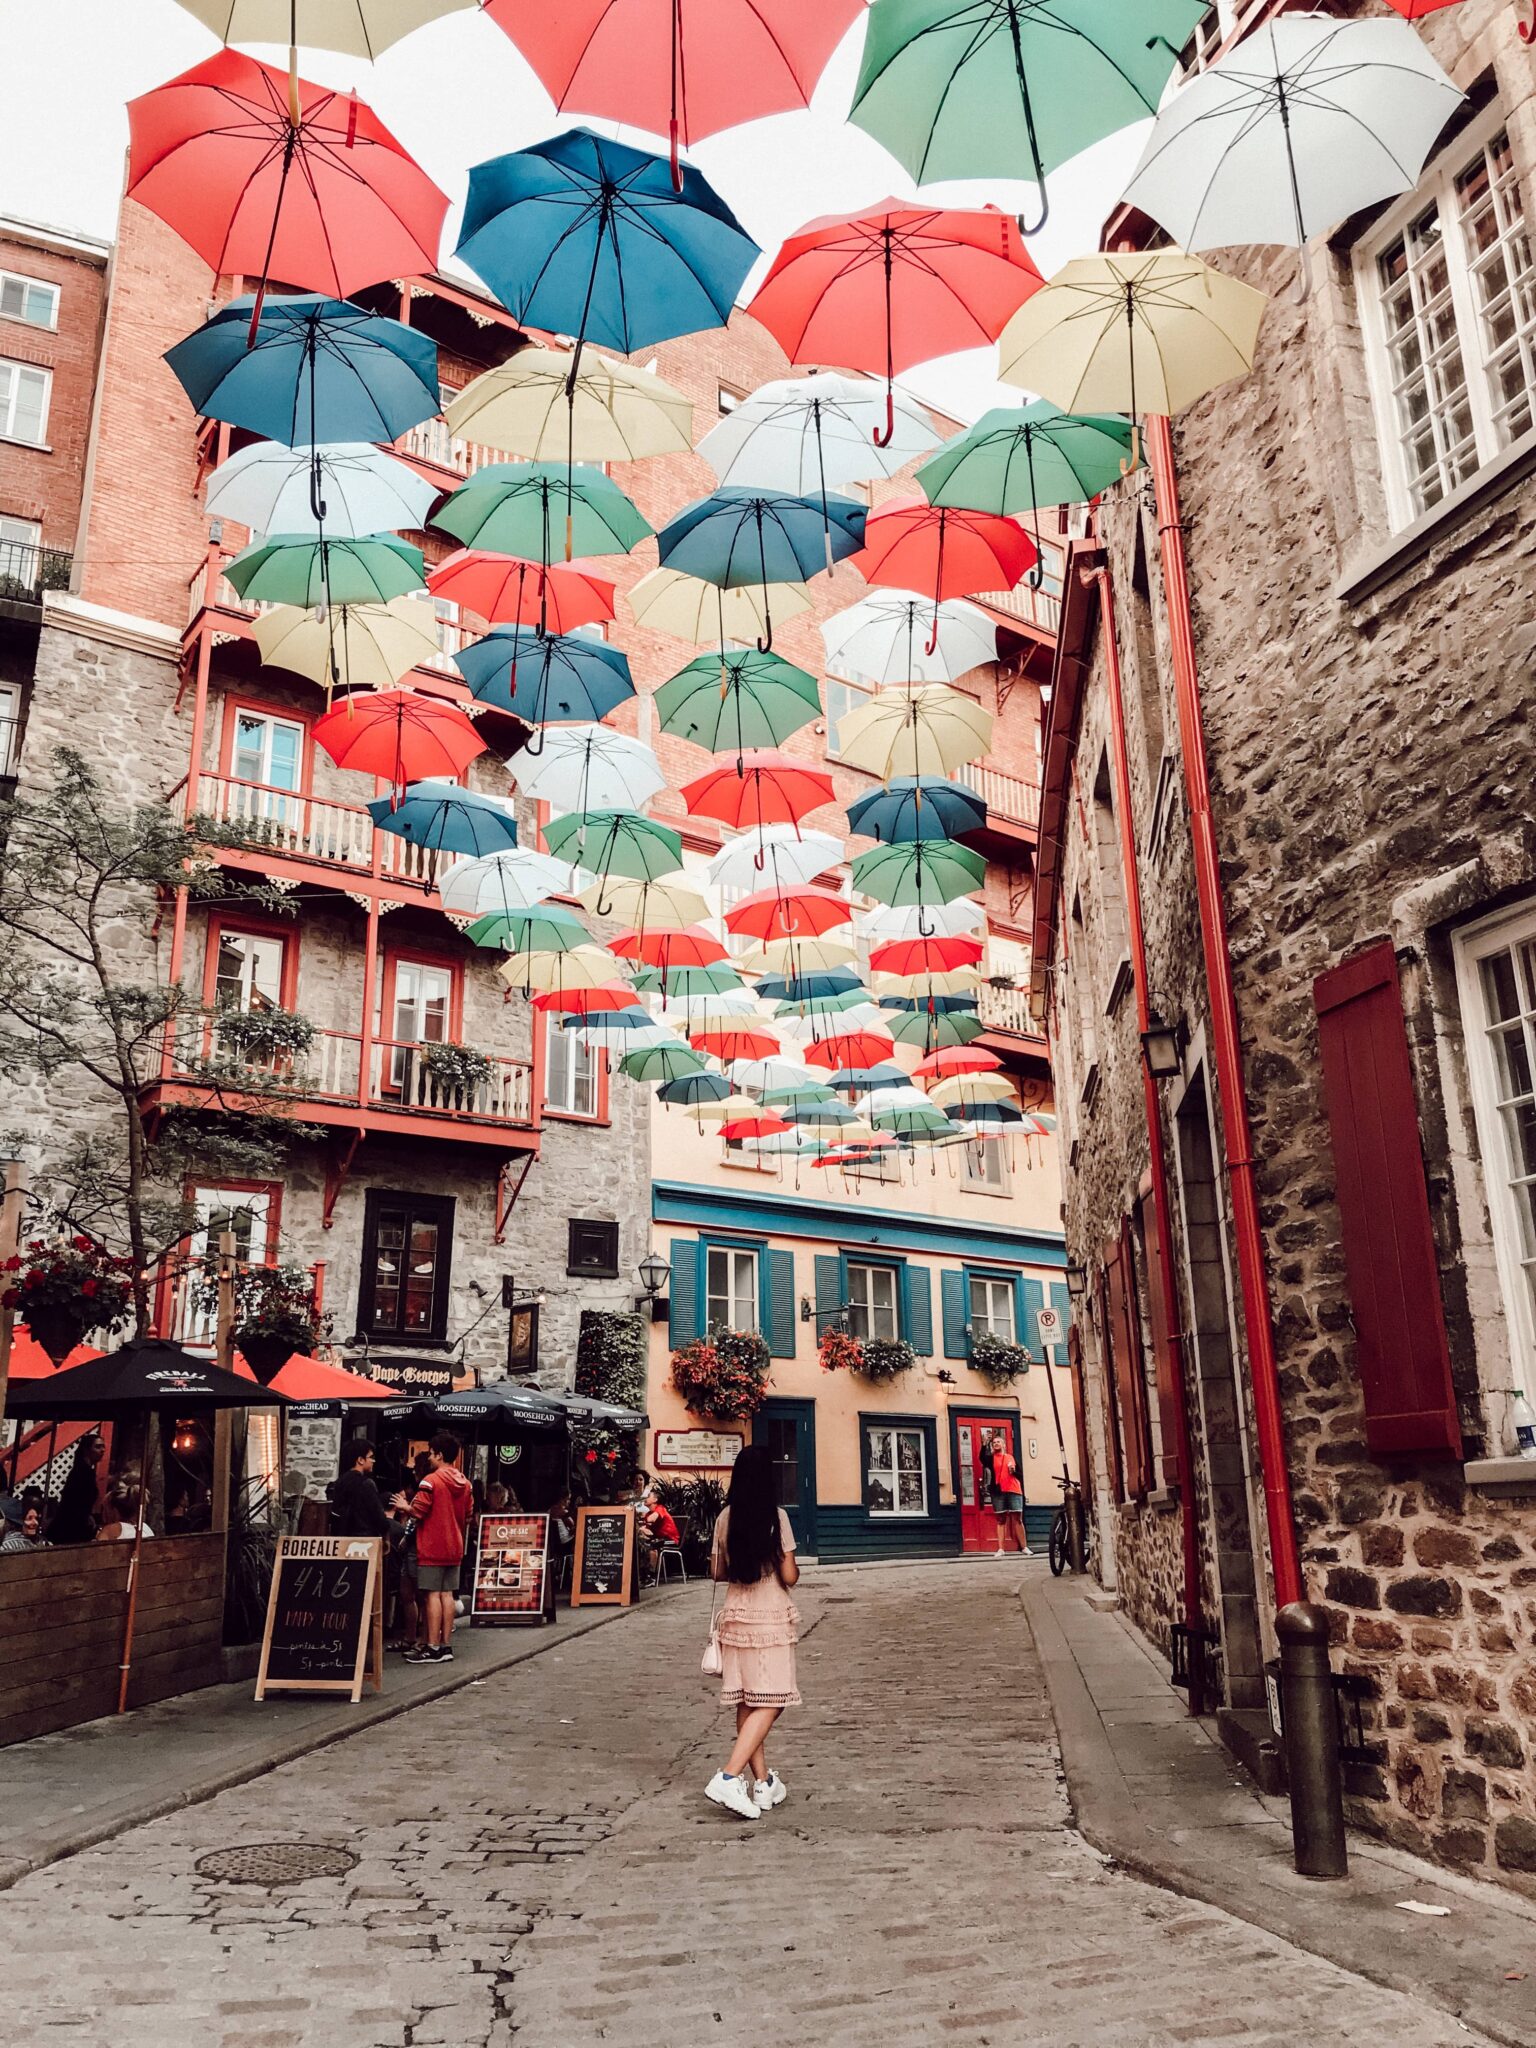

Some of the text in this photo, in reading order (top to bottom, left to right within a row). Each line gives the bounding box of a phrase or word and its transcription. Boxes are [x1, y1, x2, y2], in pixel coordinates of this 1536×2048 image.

[383, 1406, 413, 1417] MOOSEHEAD
[435, 1403, 488, 1414] MOOSEHEAD
[513, 1410, 555, 1422] MOOSEHEAD
[281, 1539, 340, 1557] BORÉALE
[293, 1566, 313, 1598] 4
[331, 1566, 351, 1599] 6
